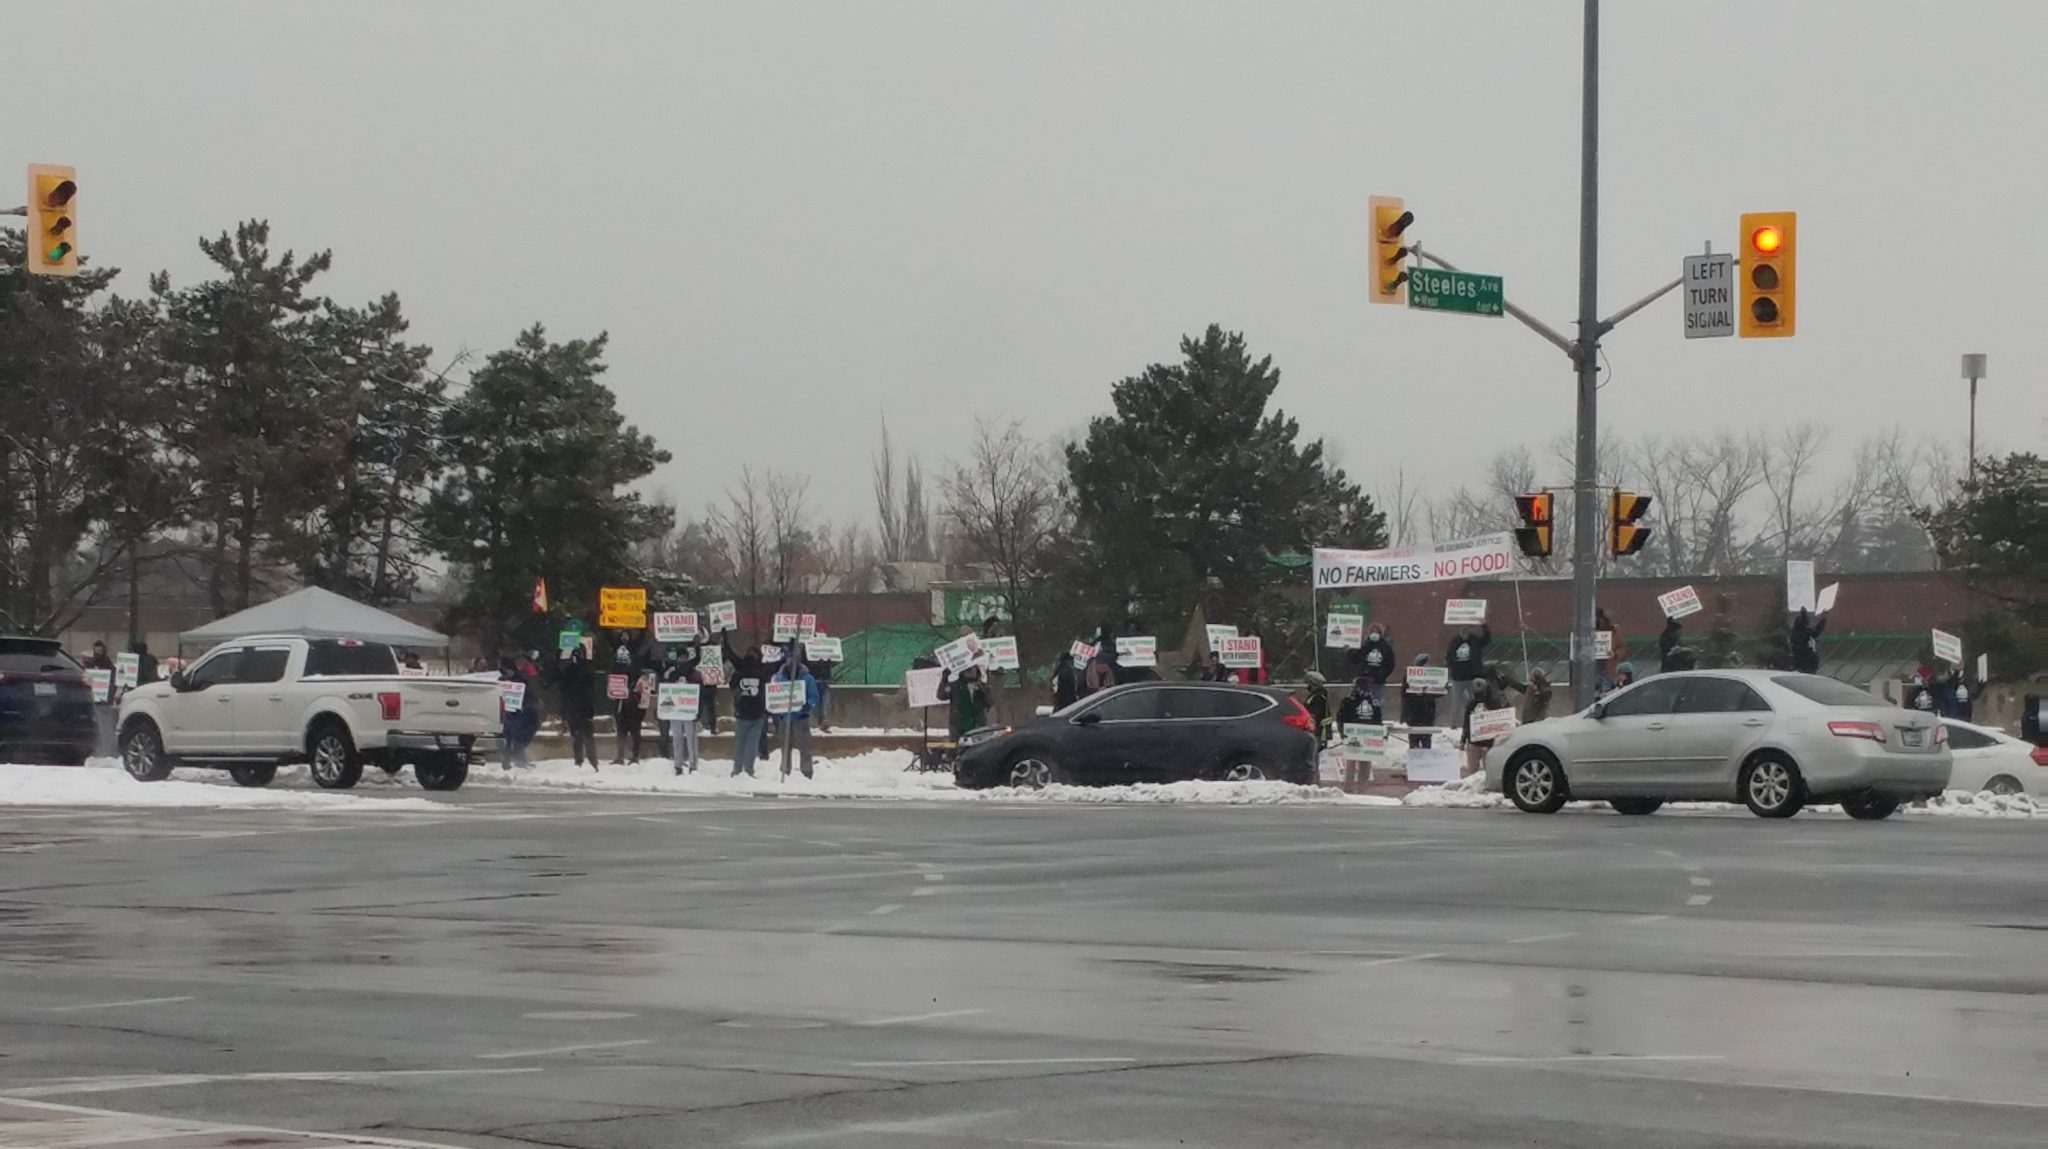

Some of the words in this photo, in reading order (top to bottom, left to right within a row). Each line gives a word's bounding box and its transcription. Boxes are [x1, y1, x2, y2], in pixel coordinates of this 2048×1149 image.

[1692, 262, 1725, 280] LEFT
[1412, 271, 1477, 298] Steeles
[1480, 279, 1499, 293] Ave
[1690, 287, 1728, 305] TURN
[1687, 311, 1731, 329] SIGNAL
[1319, 566, 1342, 585] NO
[1345, 564, 1421, 583] FARMERS
[1434, 560, 1456, 578] NO
[1461, 552, 1510, 574] FOOD!
[663, 615, 694, 625] STAND
[1227, 639, 1258, 651] STAND
